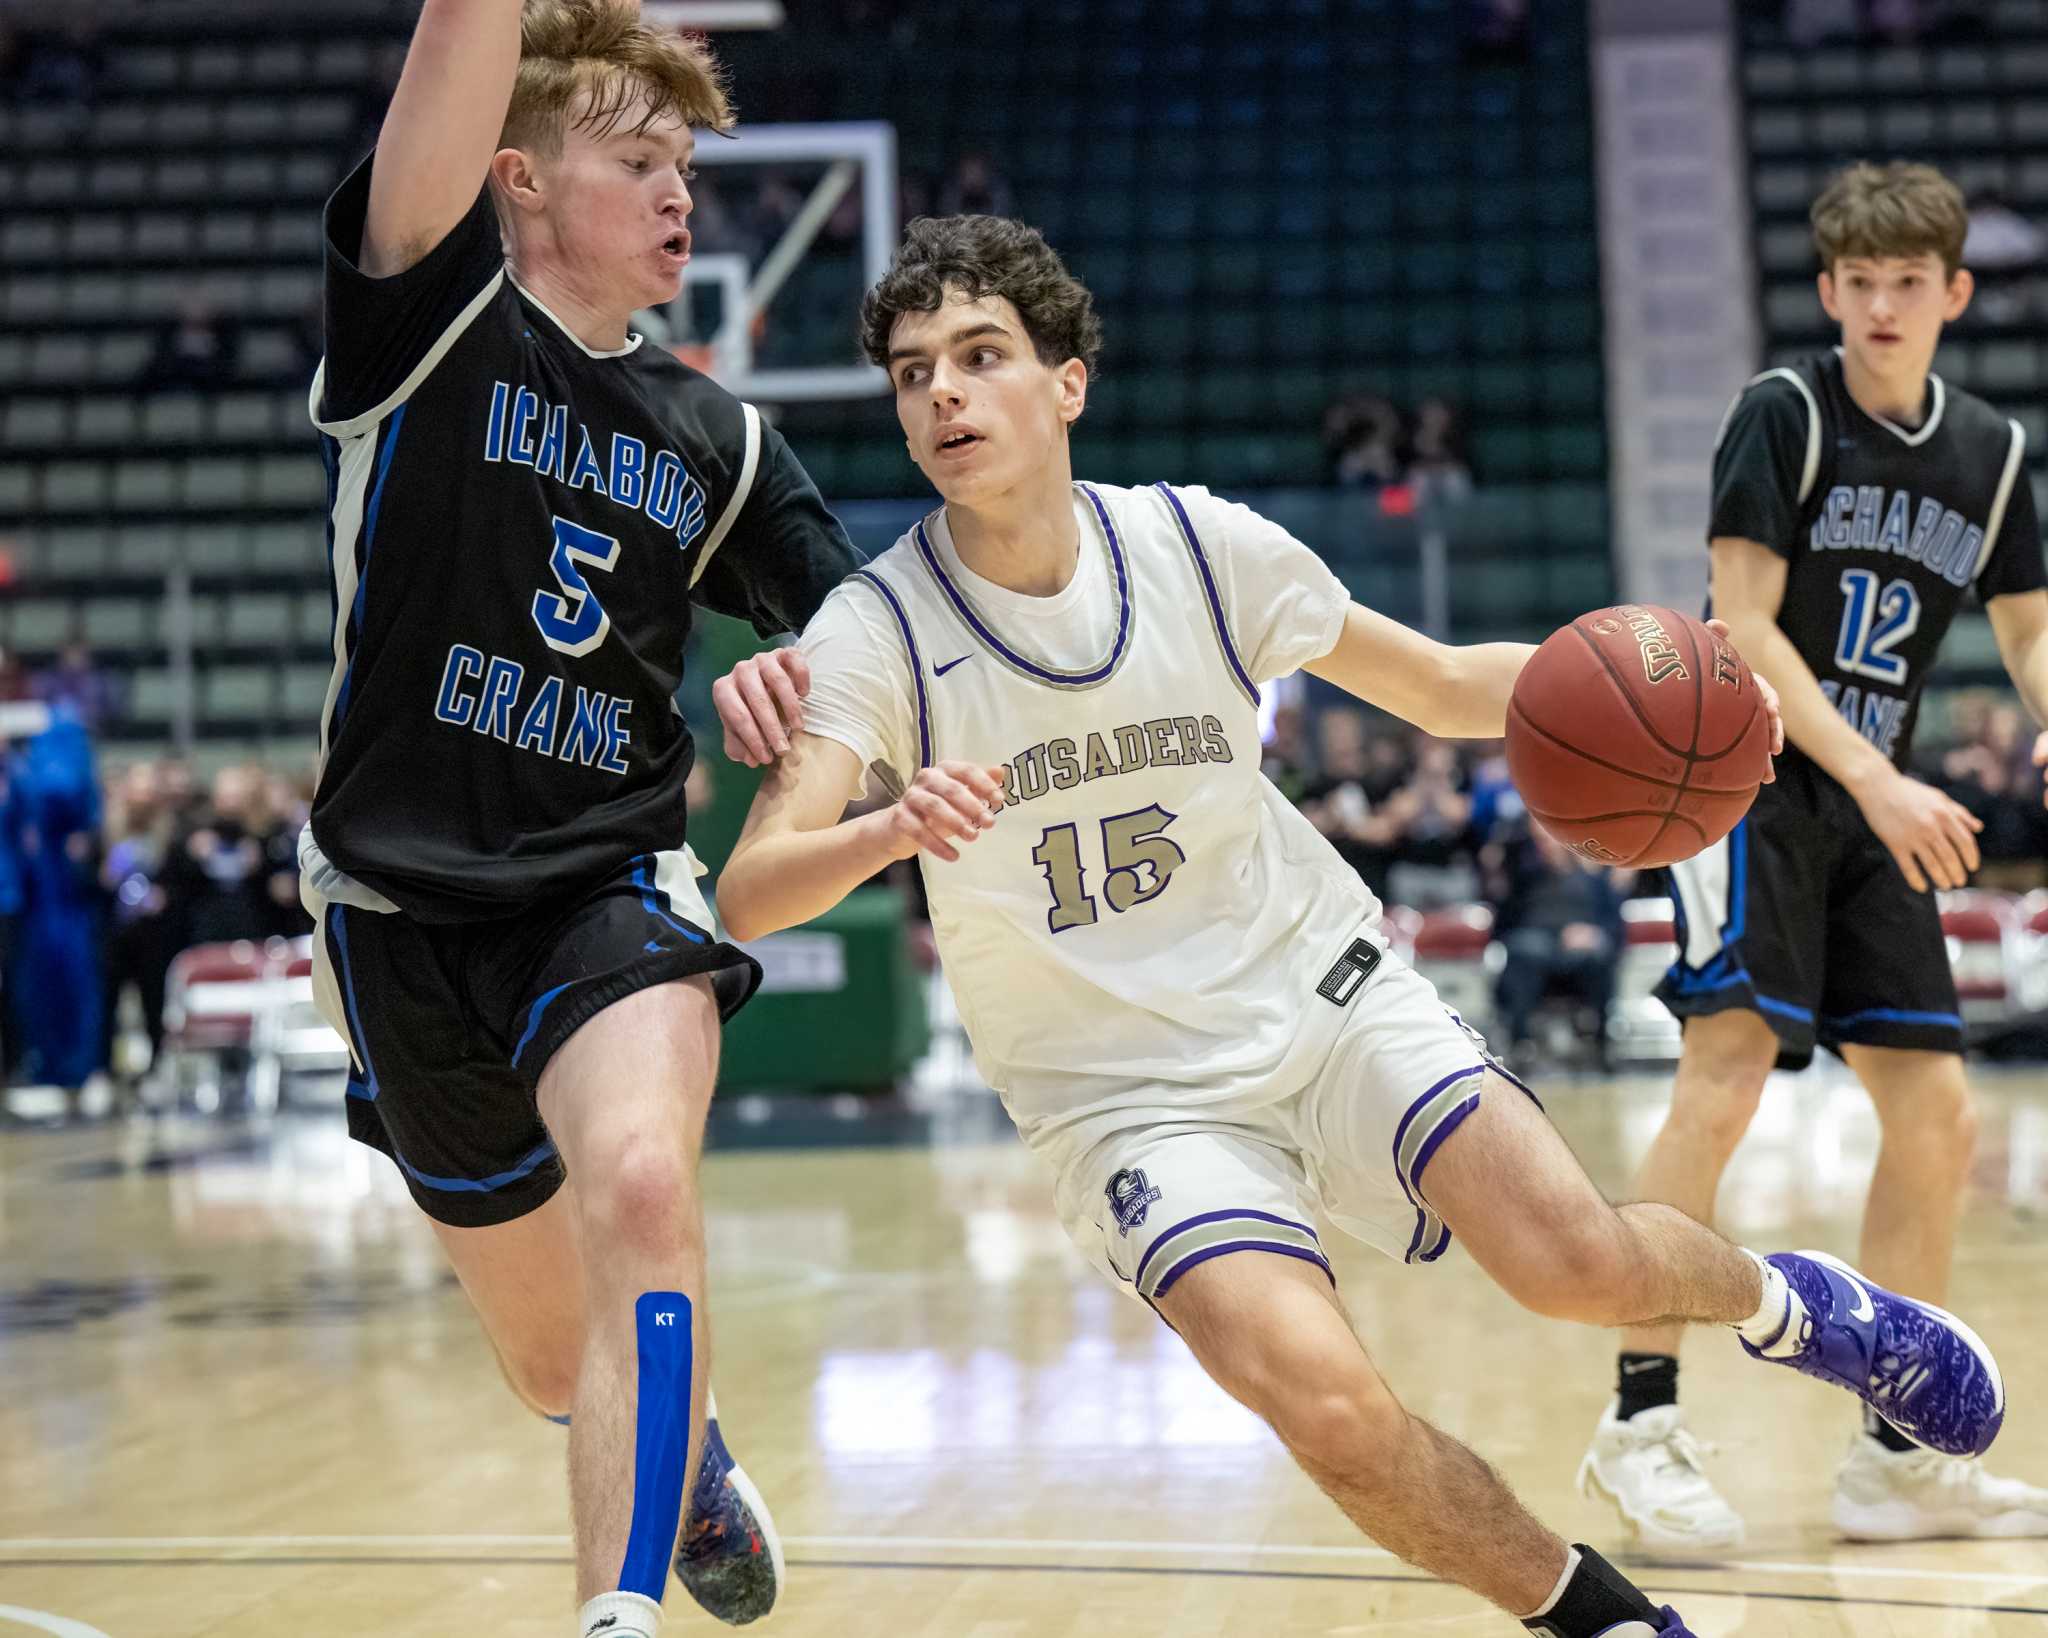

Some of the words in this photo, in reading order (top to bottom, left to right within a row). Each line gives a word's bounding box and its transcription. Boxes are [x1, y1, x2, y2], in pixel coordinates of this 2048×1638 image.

[484, 380, 707, 550] ICHABOD
[531, 514, 621, 659] 5
[1834, 568, 1922, 686] 12
[434, 642, 634, 775] CRANE
[985, 714, 1234, 816] RUSADERS
[1031, 802, 1187, 935] 15
[1356, 953, 1371, 962] L
[655, 1312, 675, 1326] KT
